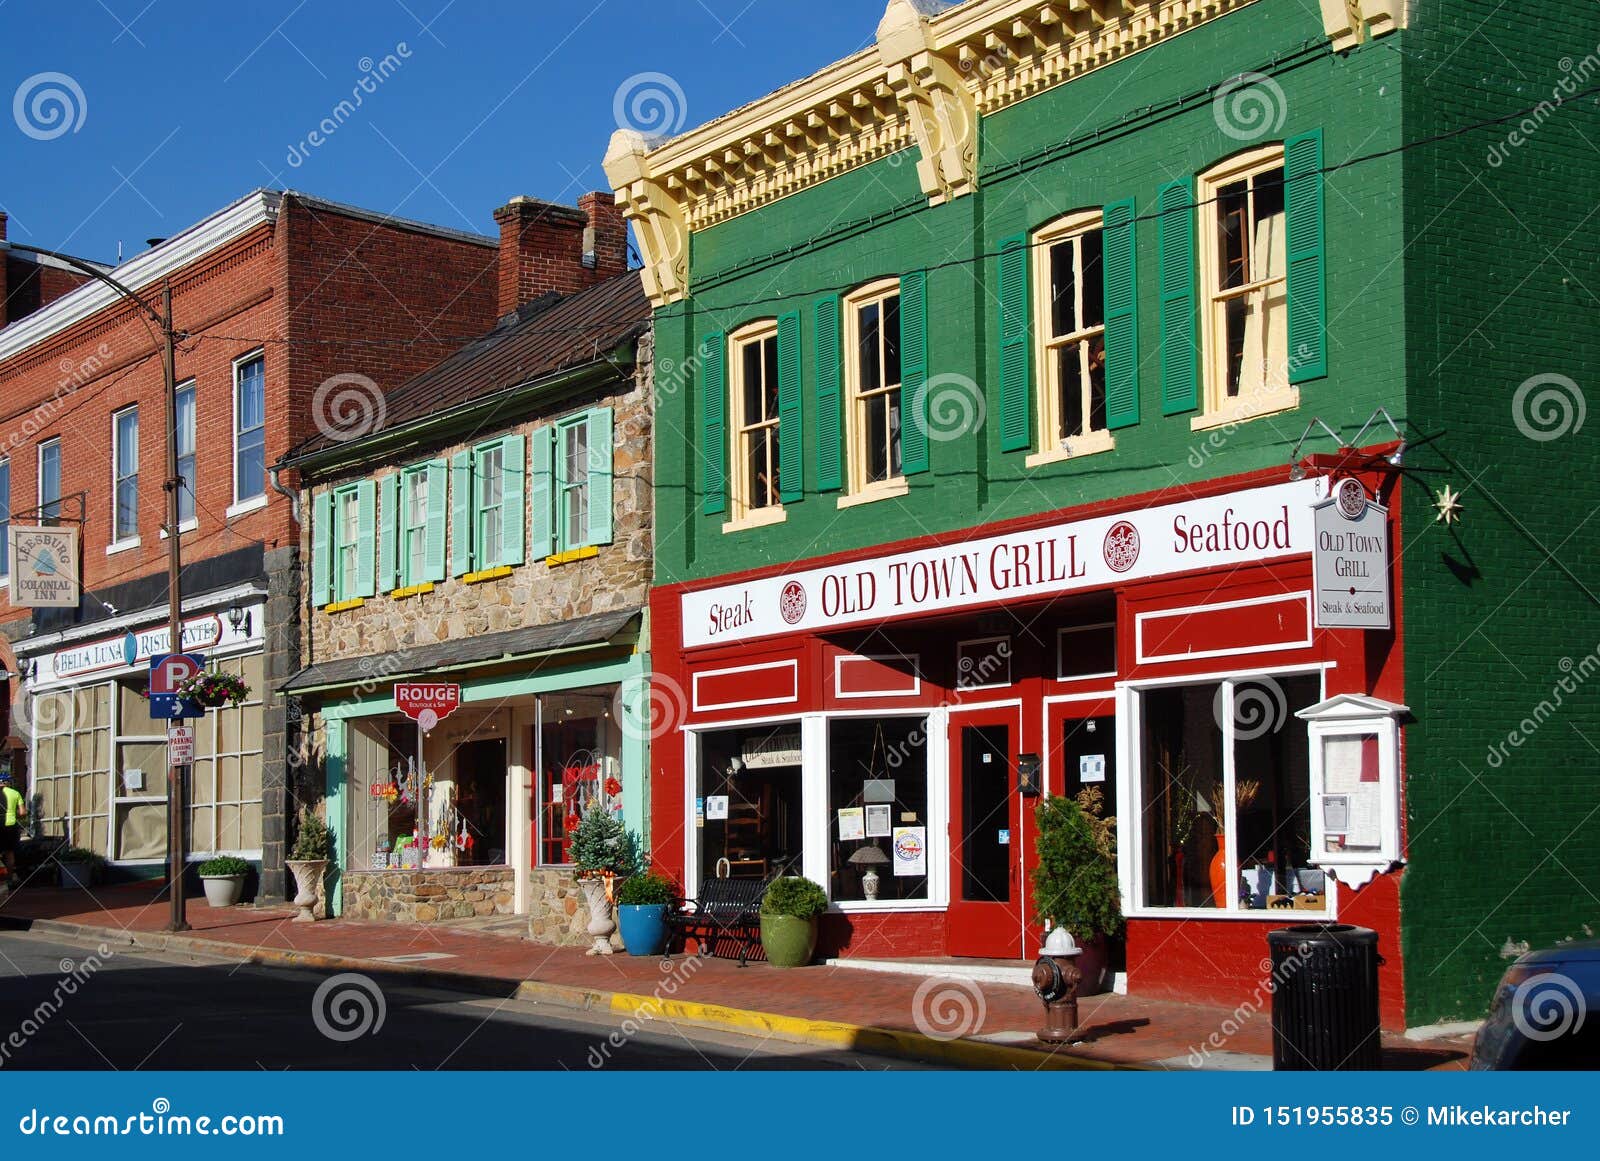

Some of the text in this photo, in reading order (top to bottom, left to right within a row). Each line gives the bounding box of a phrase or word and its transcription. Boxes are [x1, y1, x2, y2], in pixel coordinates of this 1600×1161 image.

[1173, 505, 1291, 553] Seafood
[16, 534, 70, 564] LEESBURG
[1320, 531, 1383, 553] OLD TOWN
[821, 535, 1086, 617] OLD TOWN GRILL
[1336, 557, 1369, 577] GRILL
[20, 580, 71, 591] COLONIAL
[34, 591, 57, 601] INN
[709, 590, 754, 636] Steak
[1322, 601, 1384, 614] Steak & Seafood
[61, 652, 92, 672] BELLA
[94, 643, 123, 665] LUNA
[166, 662, 190, 690] P
[400, 687, 456, 701] ROUGE
[170, 737, 192, 745] PARKING
[177, 729, 186, 737] NO
